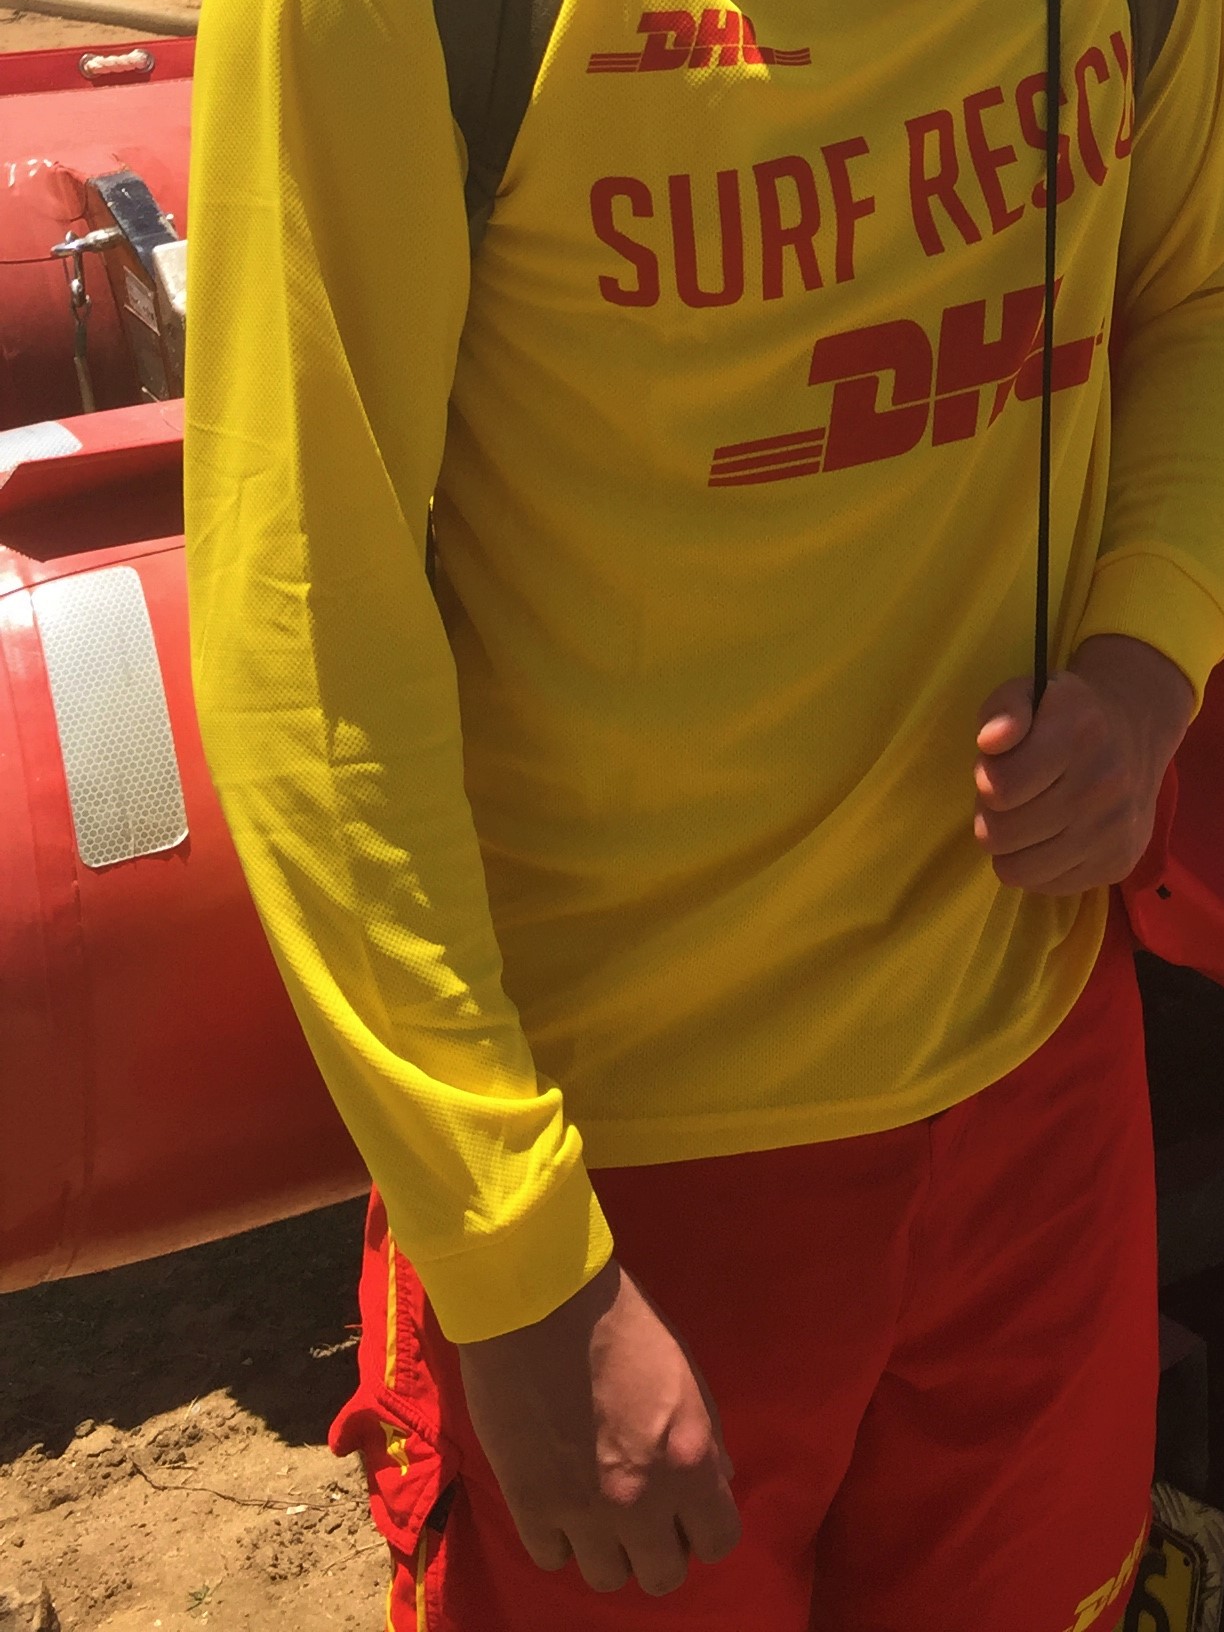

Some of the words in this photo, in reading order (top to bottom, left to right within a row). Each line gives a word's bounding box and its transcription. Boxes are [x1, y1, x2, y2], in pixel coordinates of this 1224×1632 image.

[637, 8, 774, 73] DHL
[588, 136, 875, 308] SURF
[807, 275, 1097, 473] DHL
